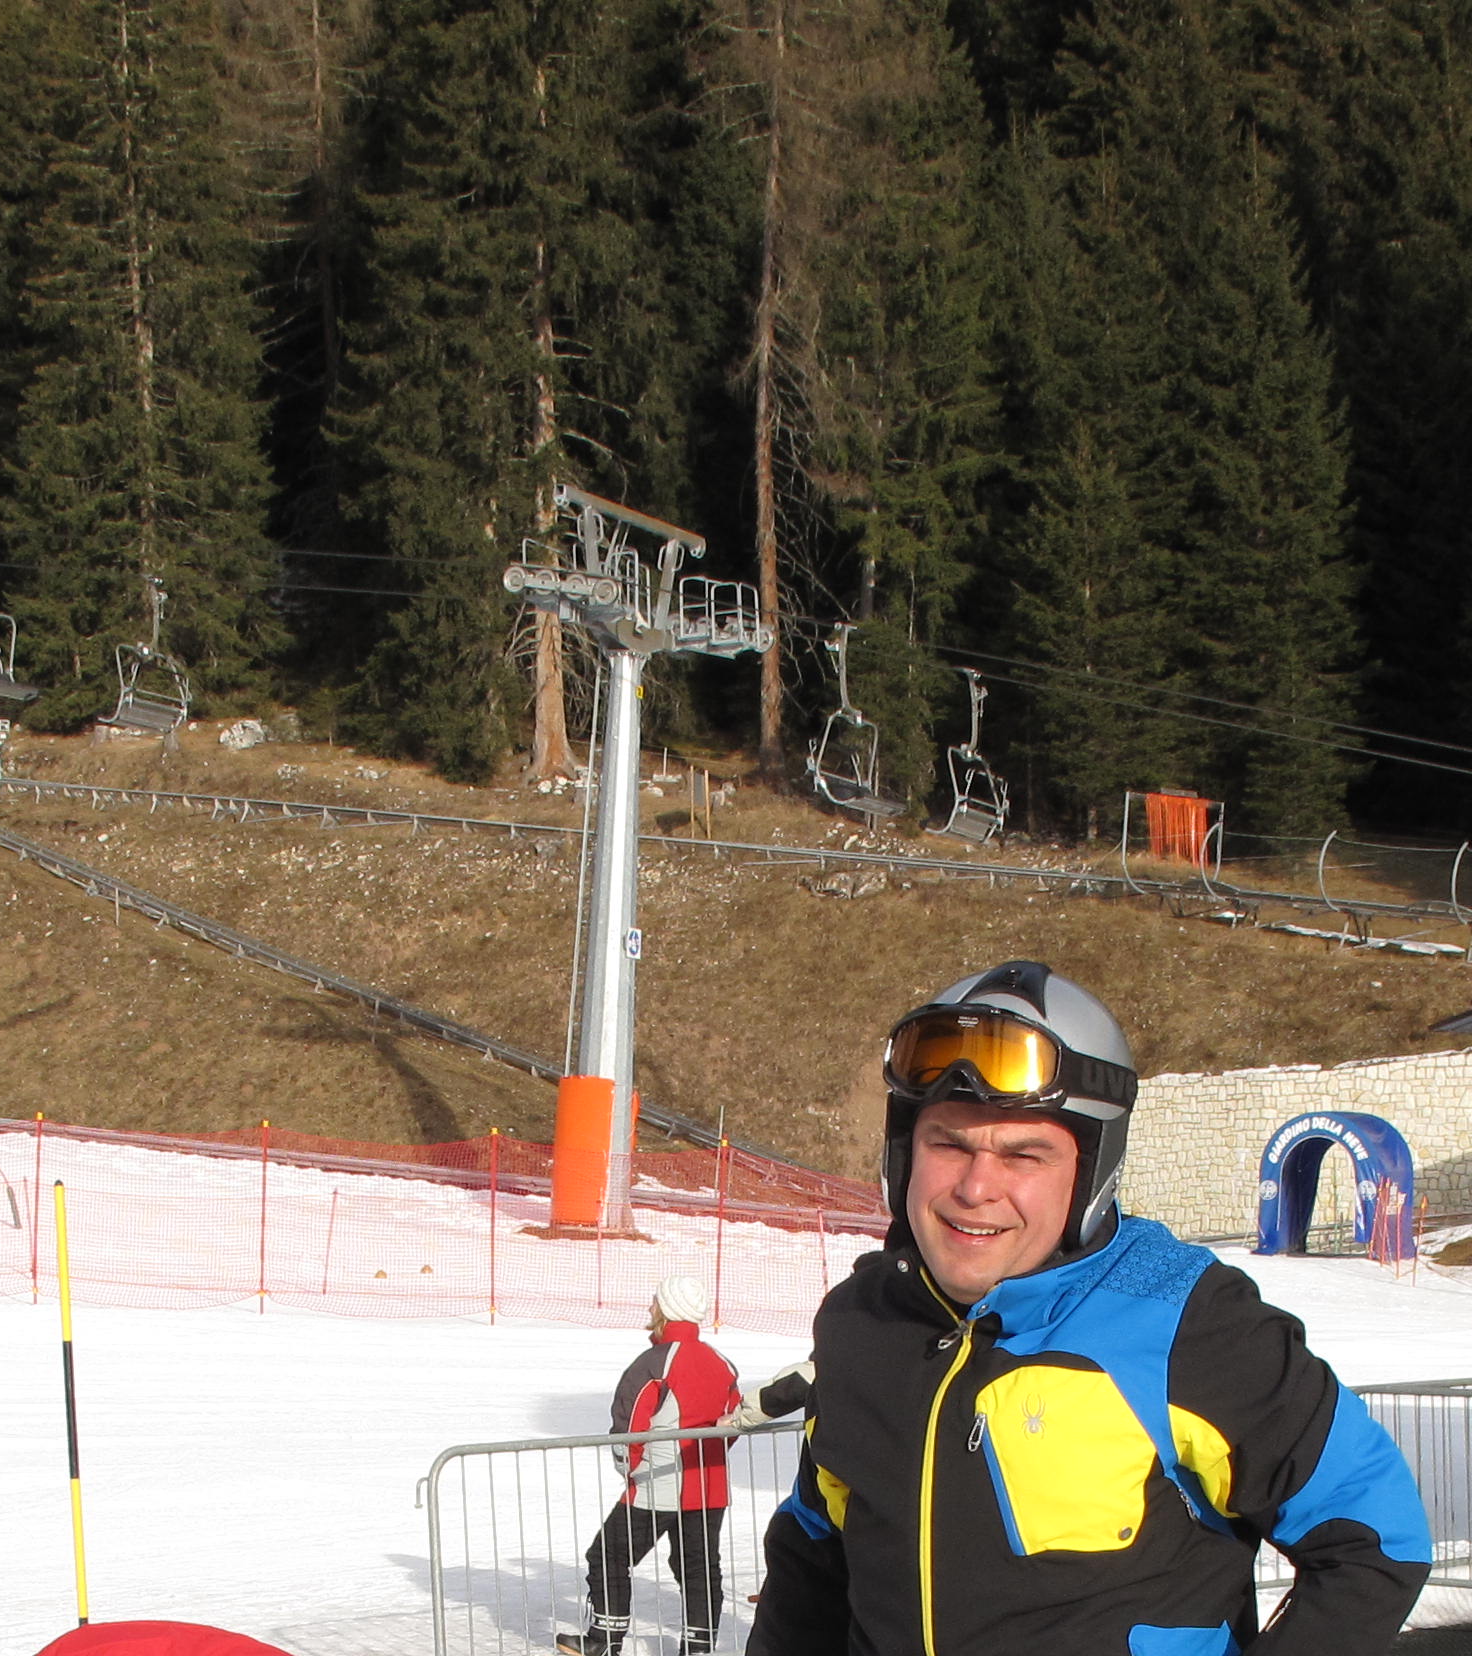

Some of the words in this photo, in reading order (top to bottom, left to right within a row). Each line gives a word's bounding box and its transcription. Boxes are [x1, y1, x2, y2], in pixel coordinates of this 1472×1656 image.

[1268, 1118, 1310, 1164] GIARDINO
[1312, 1116, 1344, 1136] DELLA
[1343, 1131, 1368, 1161] NEVE
